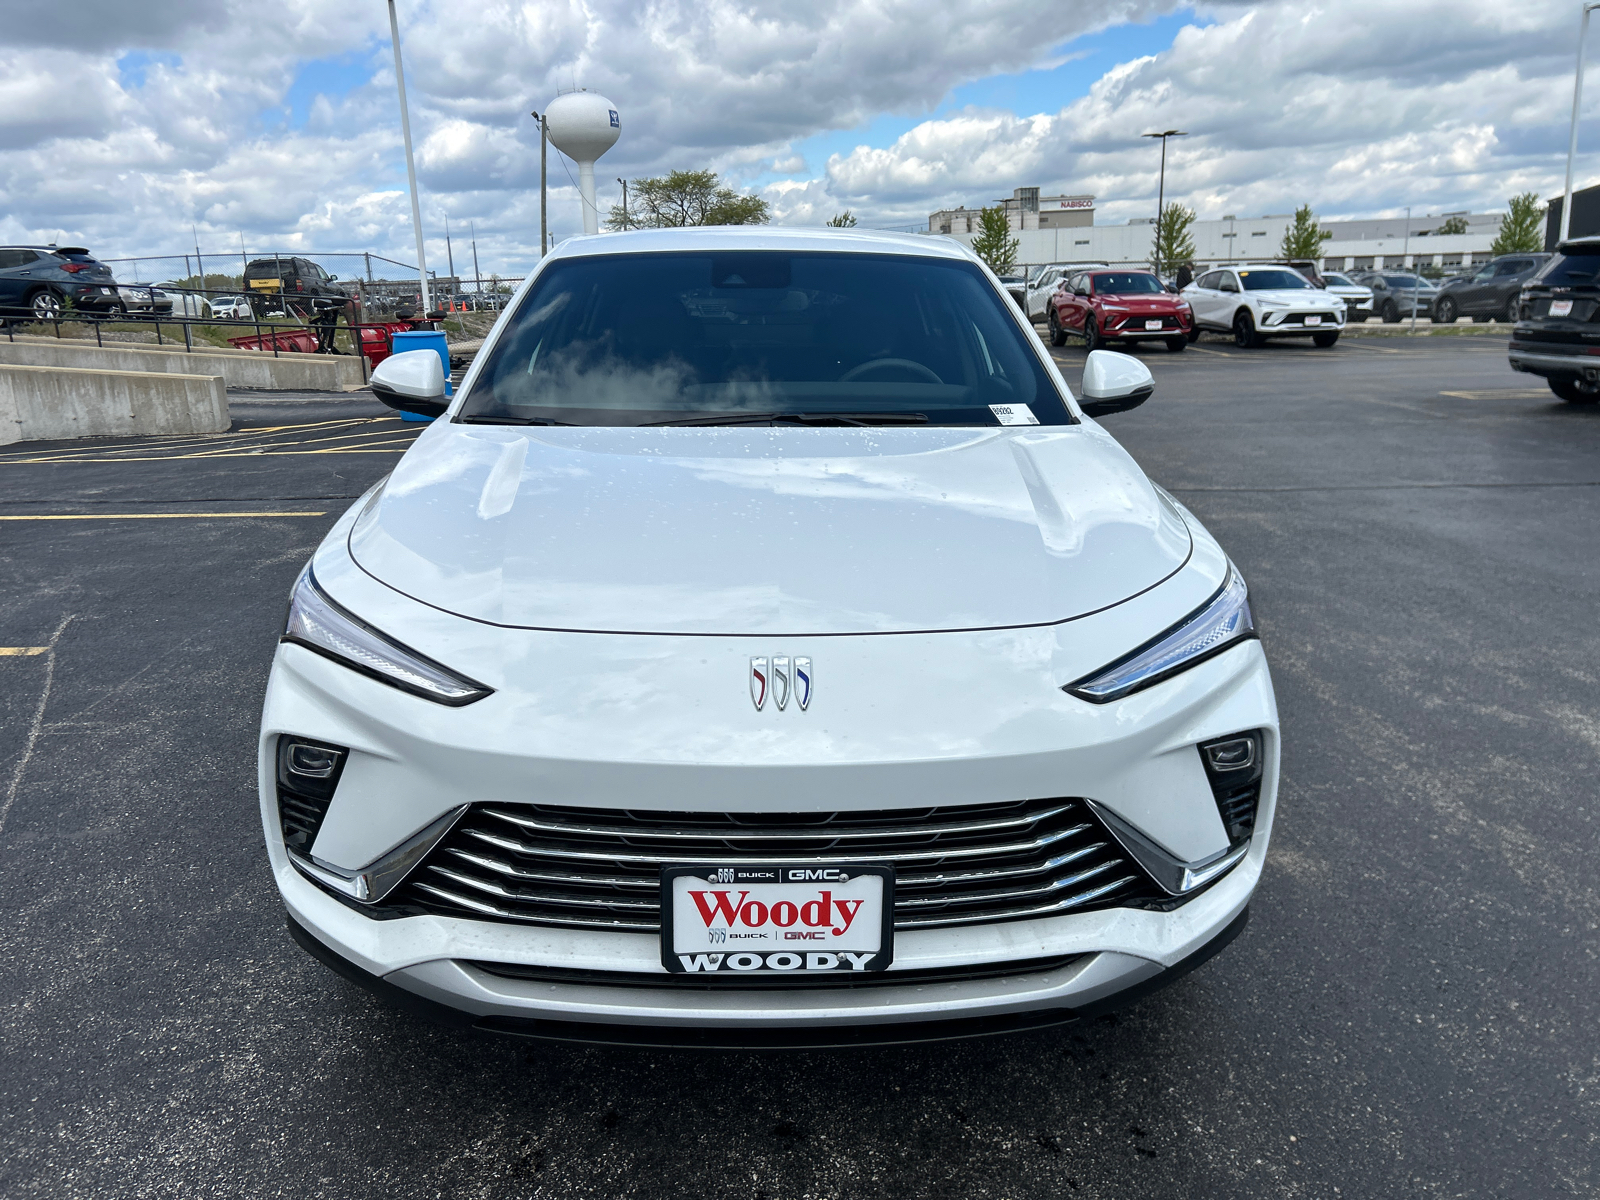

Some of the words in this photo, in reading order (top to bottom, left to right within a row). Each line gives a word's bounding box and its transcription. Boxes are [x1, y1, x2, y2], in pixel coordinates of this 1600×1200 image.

[1060, 200, 1093, 208] NABISCO
[788, 869, 840, 880] GMC
[687, 890, 865, 937] Woody
[784, 931, 826, 940] GMC
[678, 952, 877, 973] WOODY
